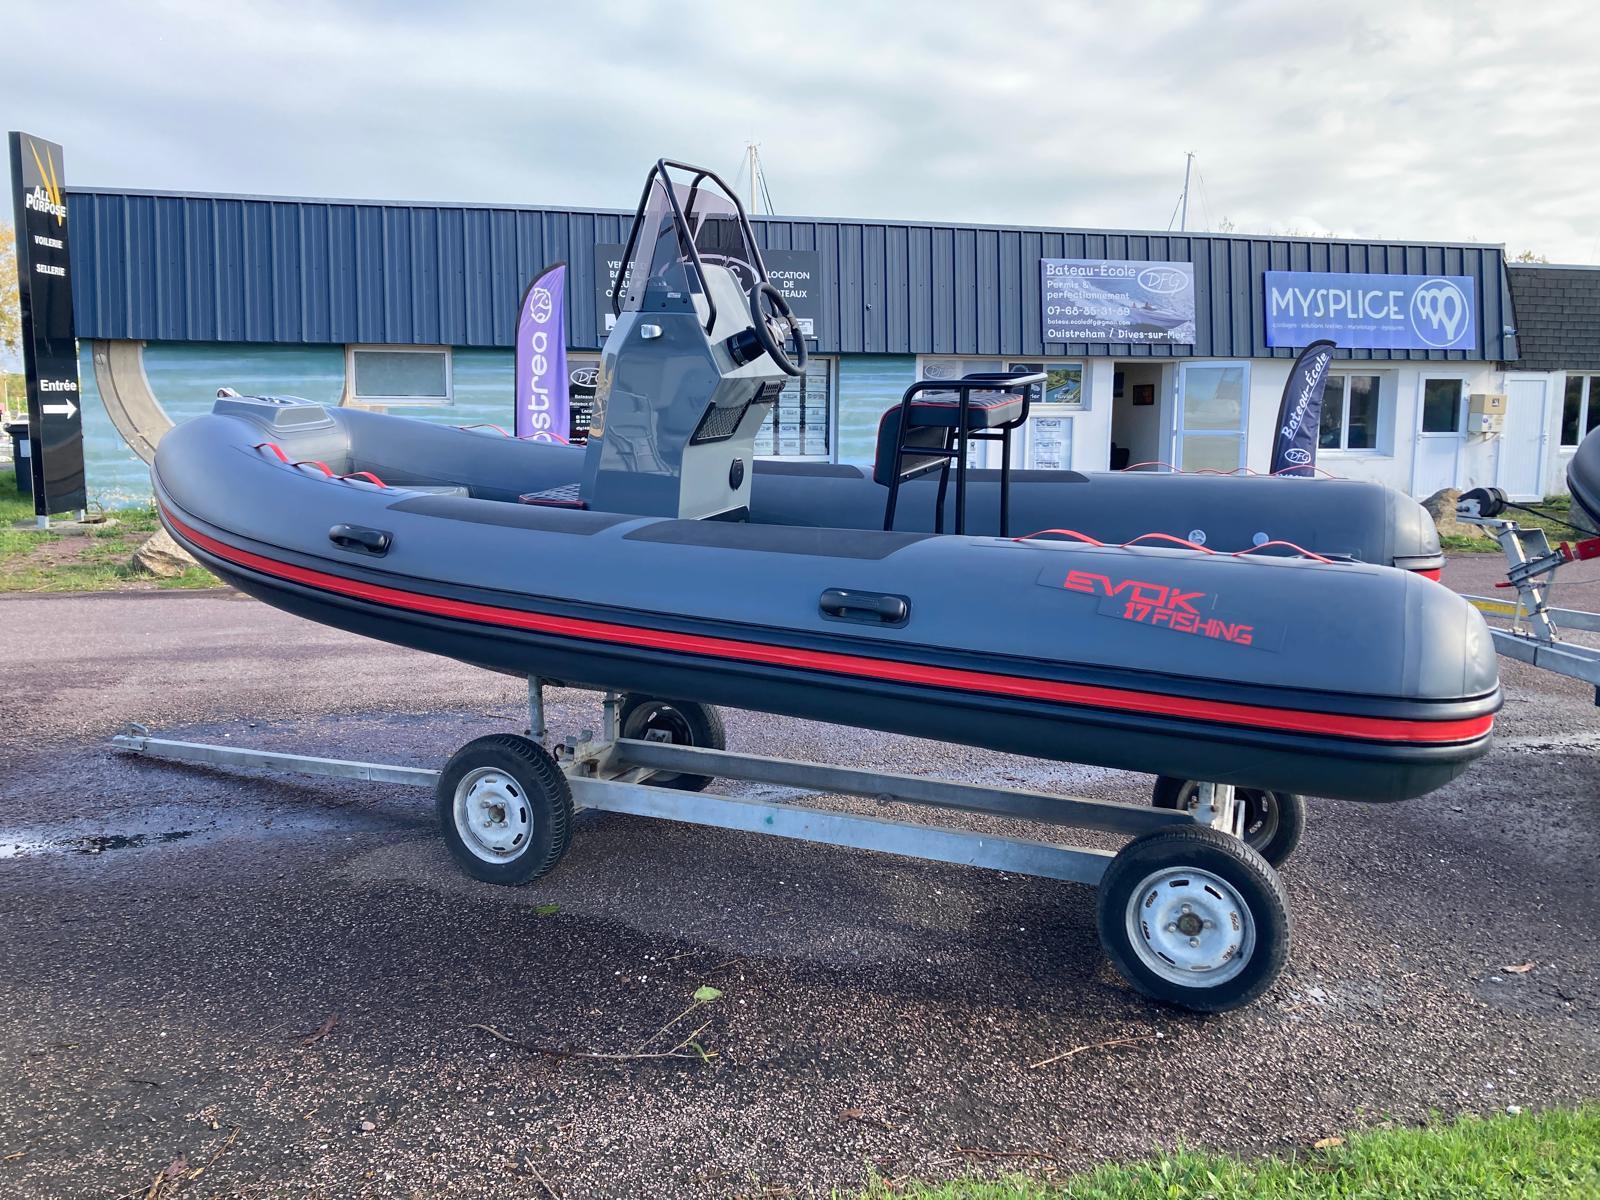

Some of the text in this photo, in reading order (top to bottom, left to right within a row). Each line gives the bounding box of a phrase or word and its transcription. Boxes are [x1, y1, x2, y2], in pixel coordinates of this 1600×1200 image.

[34, 185, 50, 202] ALL
[26, 193, 67, 217] PURPOSE
[34, 235, 63, 249] VOILERIE
[36, 263, 66, 276] SELLERIE
[607, 261, 635, 269] VETE
[1046, 262, 1136, 277] Bateau-École
[767, 271, 810, 279] LOCATION
[1147, 272, 1180, 296] DFG
[777, 290, 808, 298] TEAUX
[1047, 290, 1130, 301] perfectionnement
[1272, 287, 1405, 320] MYSPLICE
[1047, 328, 1106, 338] Ouistreham
[1118, 329, 1186, 339] Dives-sur-Mer
[40, 379, 77, 392] Entrée
[1281, 352, 1327, 440] Bateau-École
[1063, 570, 1206, 614] EVOK
[1123, 602, 1254, 645] 17 FISHING
